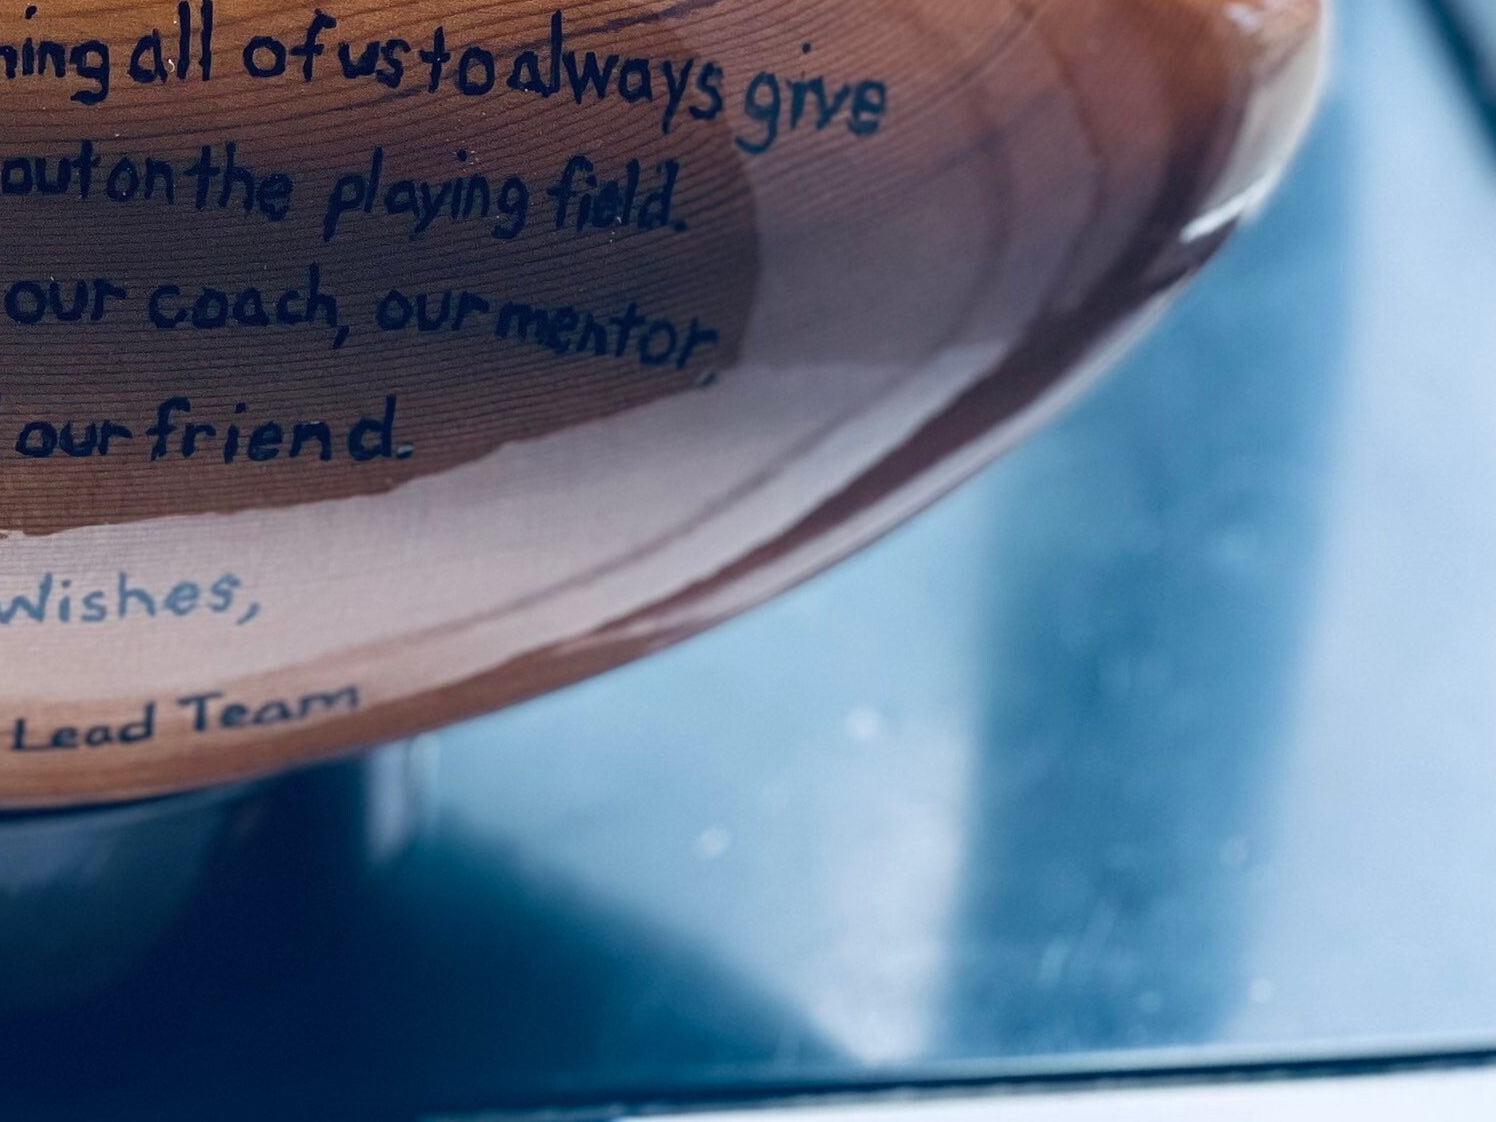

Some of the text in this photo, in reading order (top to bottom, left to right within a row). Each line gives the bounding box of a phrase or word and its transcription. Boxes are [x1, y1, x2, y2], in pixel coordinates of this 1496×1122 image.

[241, 7, 338, 83] of
[336, 33, 406, 82] us
[418, 24, 497, 96] to
[505, 8, 726, 136] always
[734, 41, 889, 156] give
[0, 137, 104, 201] out
[104, 152, 178, 208] on
[180, 139, 294, 224] the
[322, 144, 530, 242] playing
[546, 152, 690, 235] field.
[4, 277, 129, 329] our
[146, 262, 352, 351] coach,
[375, 288, 491, 334] our
[494, 300, 722, 387] mentor,
[15, 418, 133, 462] our
[145, 393, 415, 465] friend.
[10, 700, 157, 754] Lead
[178, 683, 364, 734] Team
